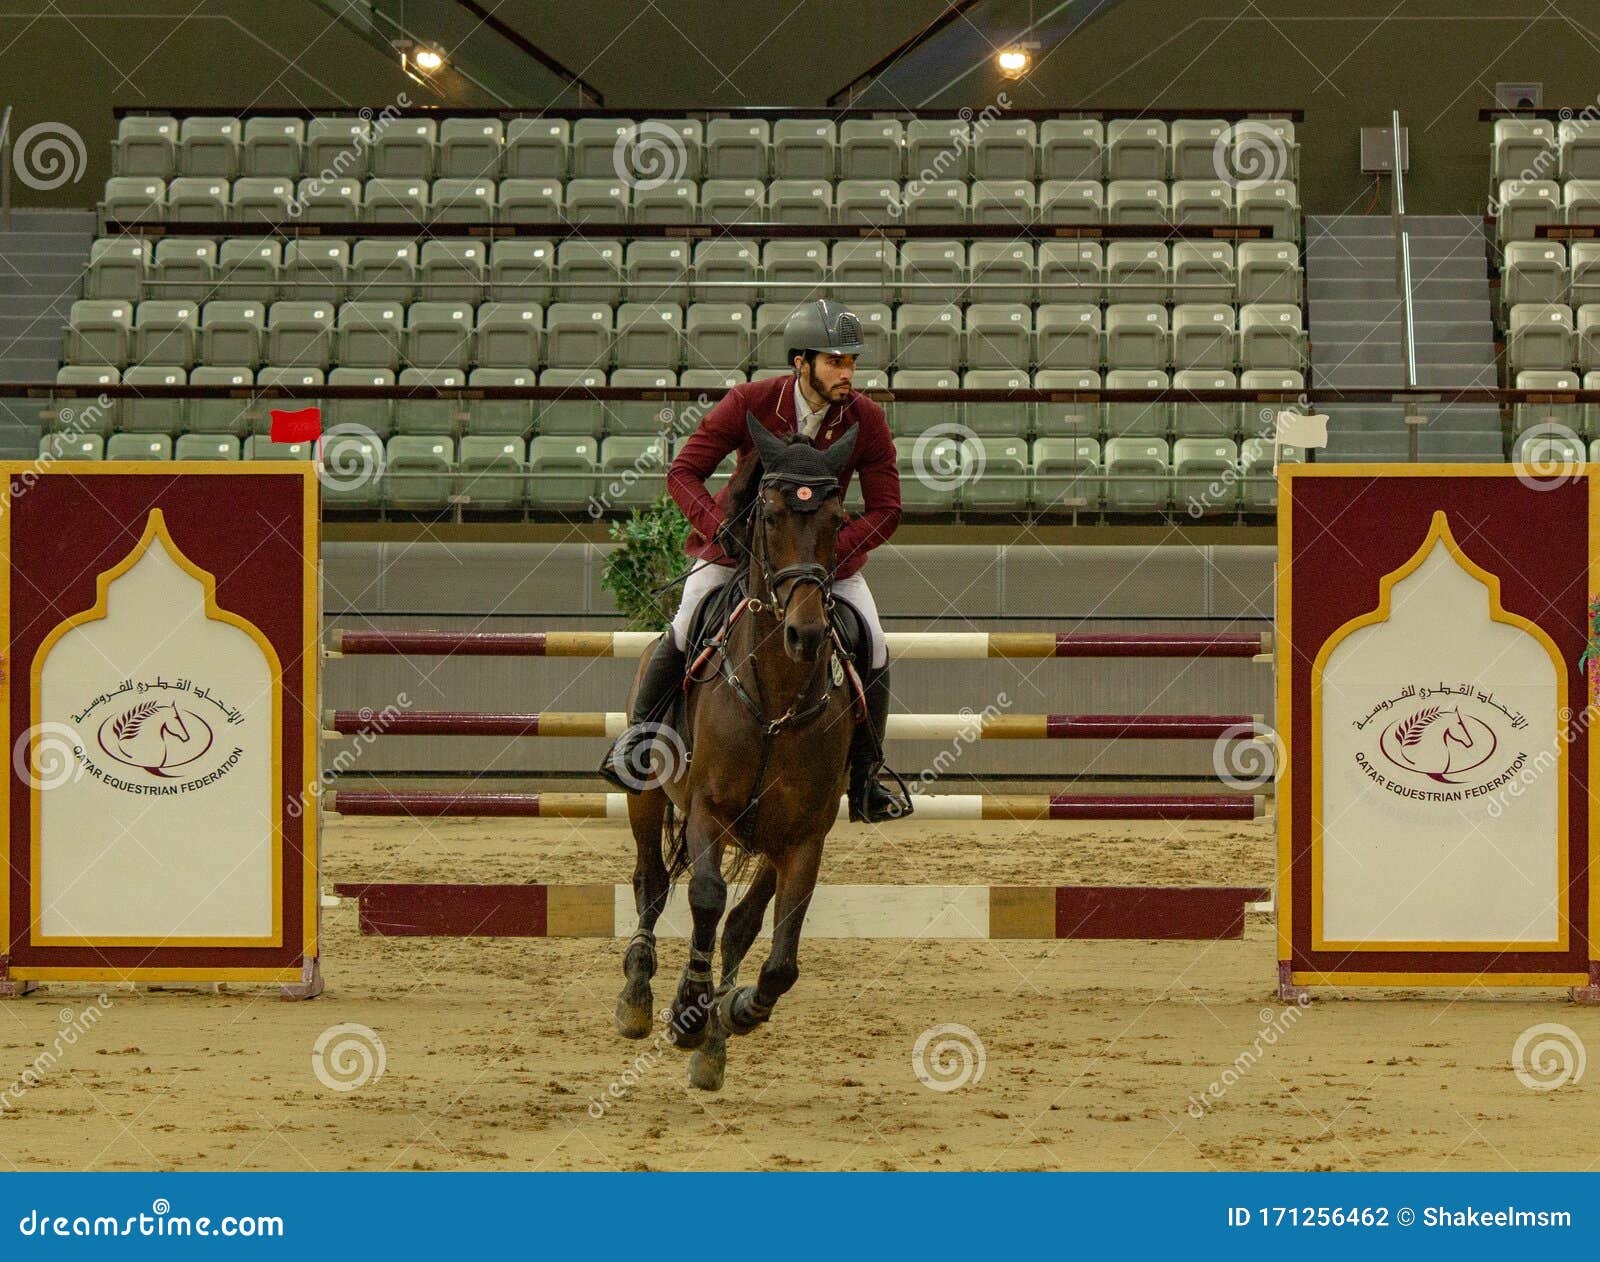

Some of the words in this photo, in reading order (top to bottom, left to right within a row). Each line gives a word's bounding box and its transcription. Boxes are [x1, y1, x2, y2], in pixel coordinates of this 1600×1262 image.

[70, 679, 134, 724] للفروسية
[136, 676, 192, 694] القطري
[1352, 684, 1416, 731] للفروسية
[1418, 681, 1475, 699] القطري
[73, 745, 103, 779] QATAR
[102, 773, 178, 796] EQUESTRIAN
[181, 747, 244, 794] FEDERATION
[1355, 751, 1386, 785] QATAR
[1385, 780, 1462, 802] EQUESTRIAN
[1465, 752, 1528, 799] FEDERATION
